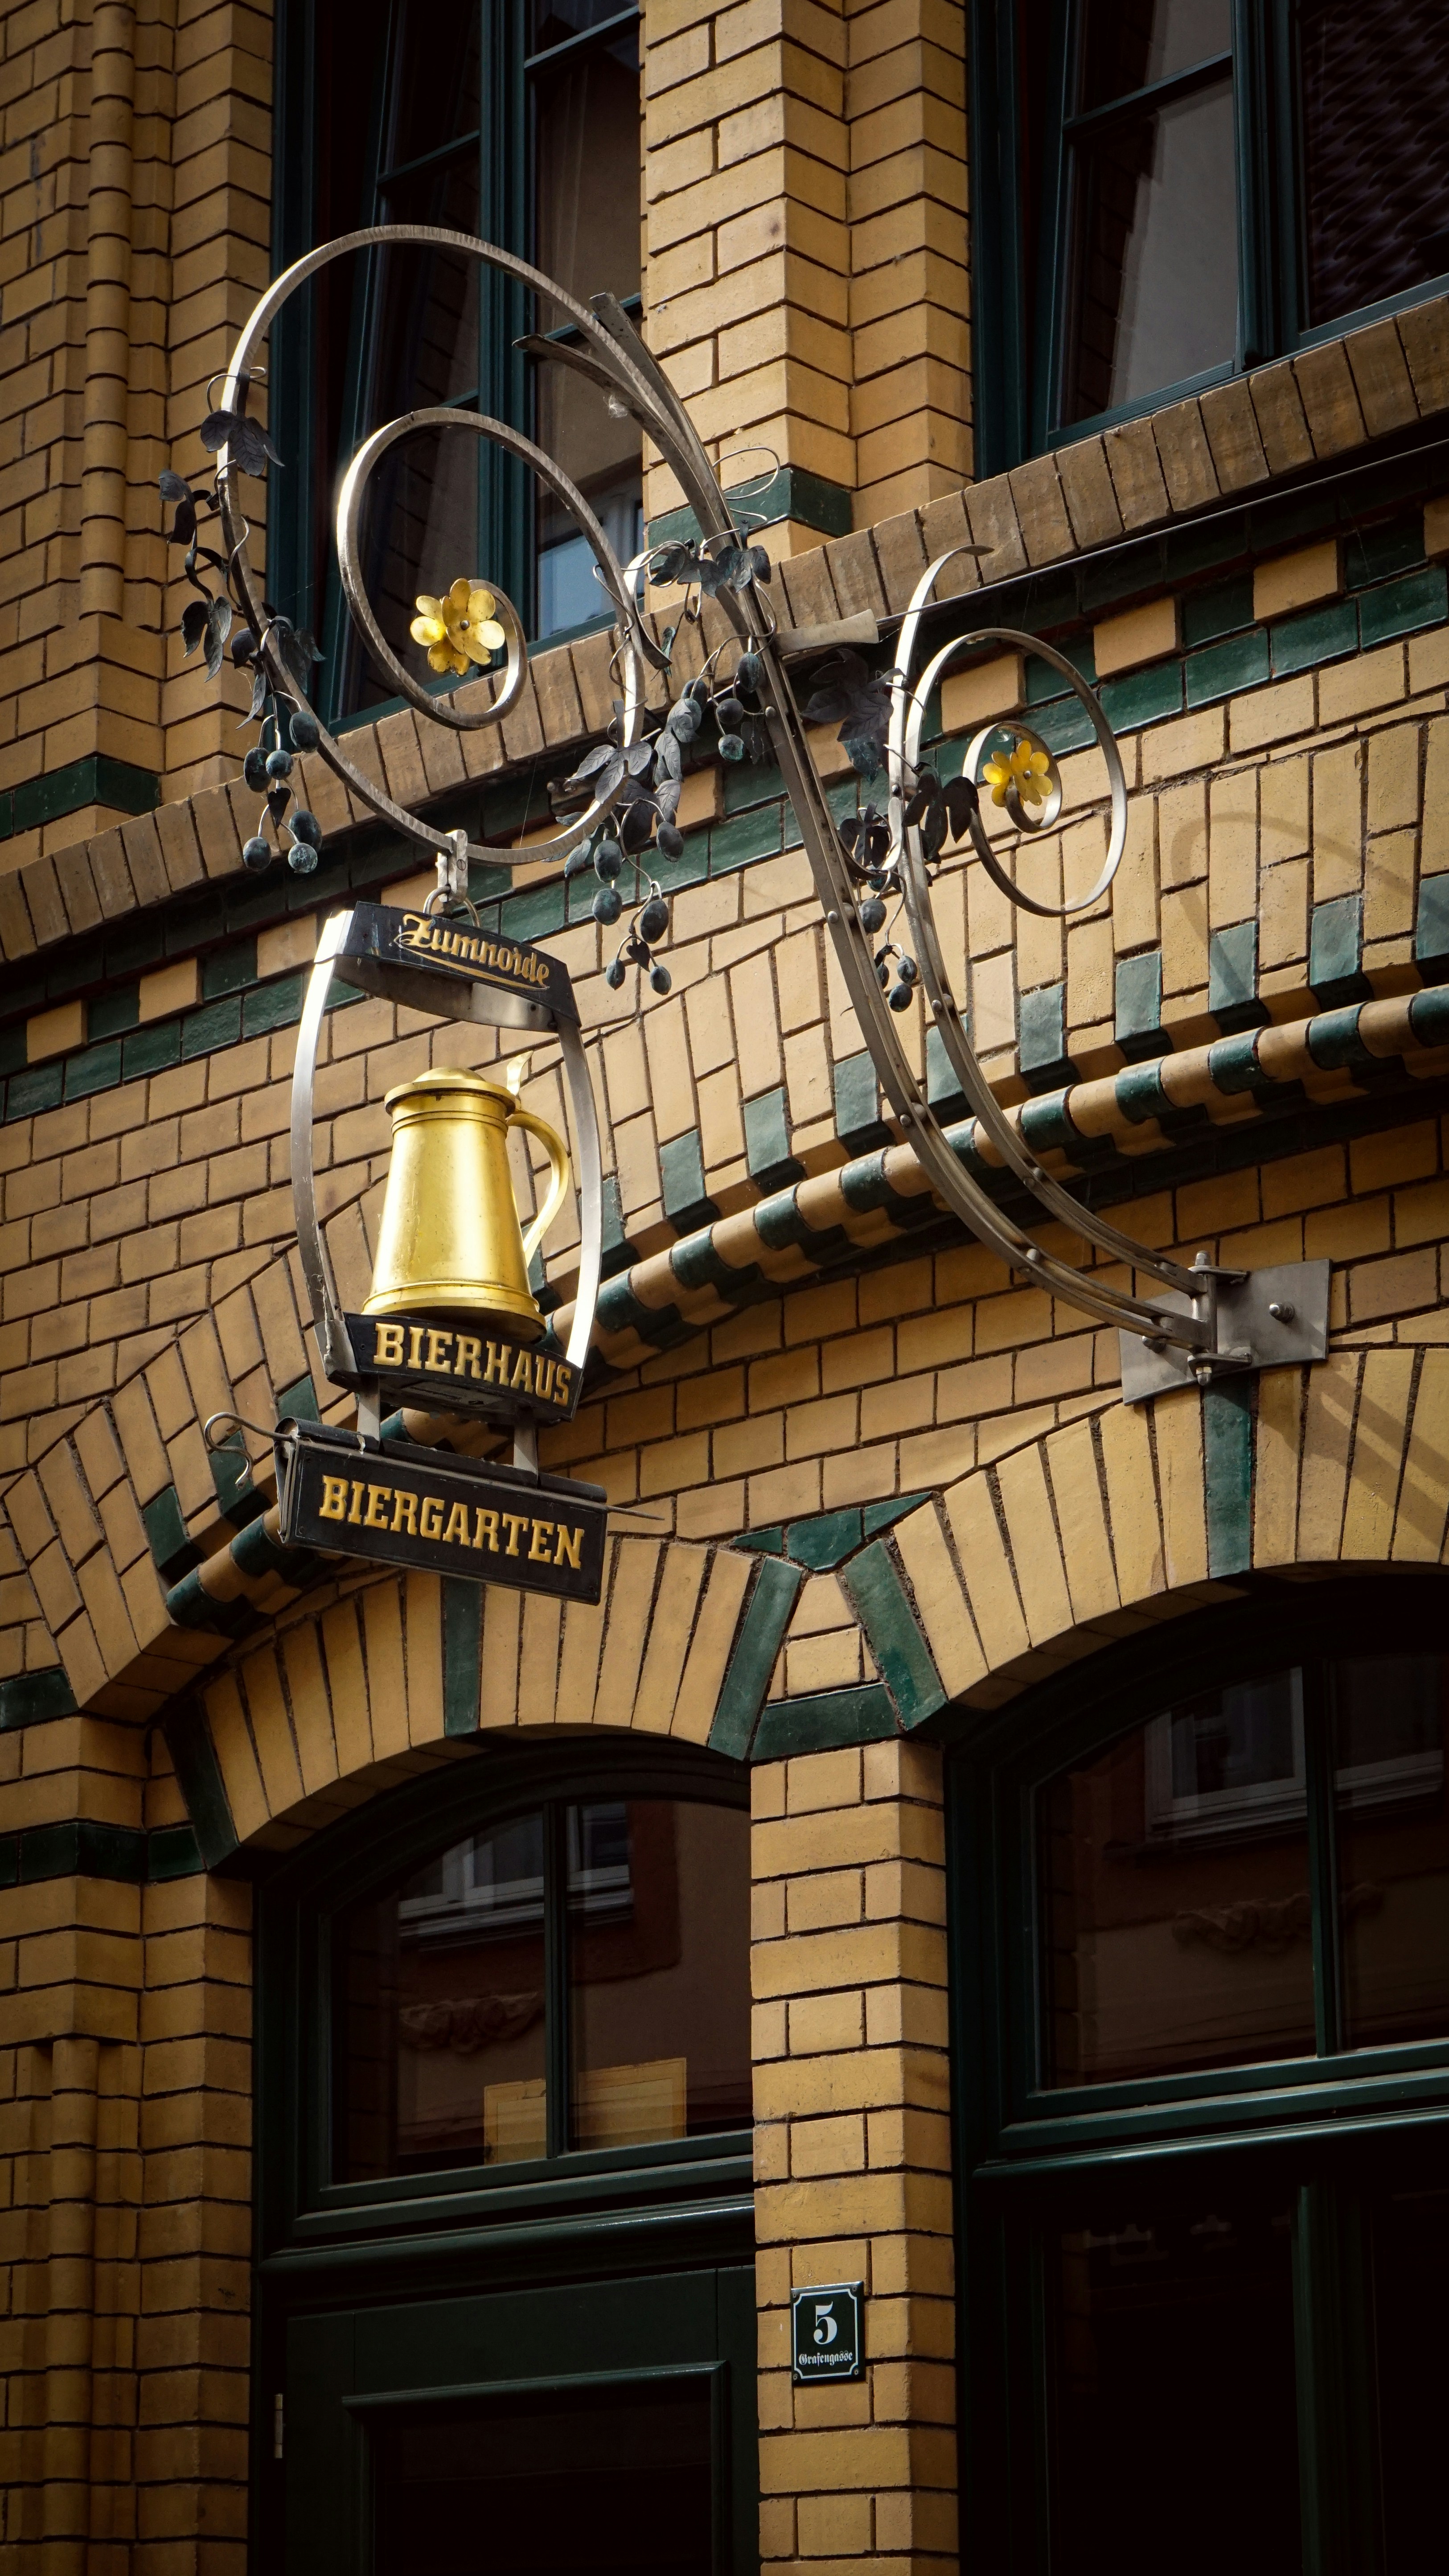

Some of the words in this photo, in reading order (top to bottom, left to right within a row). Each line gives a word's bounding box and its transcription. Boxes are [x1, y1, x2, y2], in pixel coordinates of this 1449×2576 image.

[373, 1323, 572, 1407] BIERHAUS
[319, 1475, 585, 1570] BIERGARTEN
[813, 2301, 837, 2345] 5
[799, 2350, 853, 2367] Grafengasse
